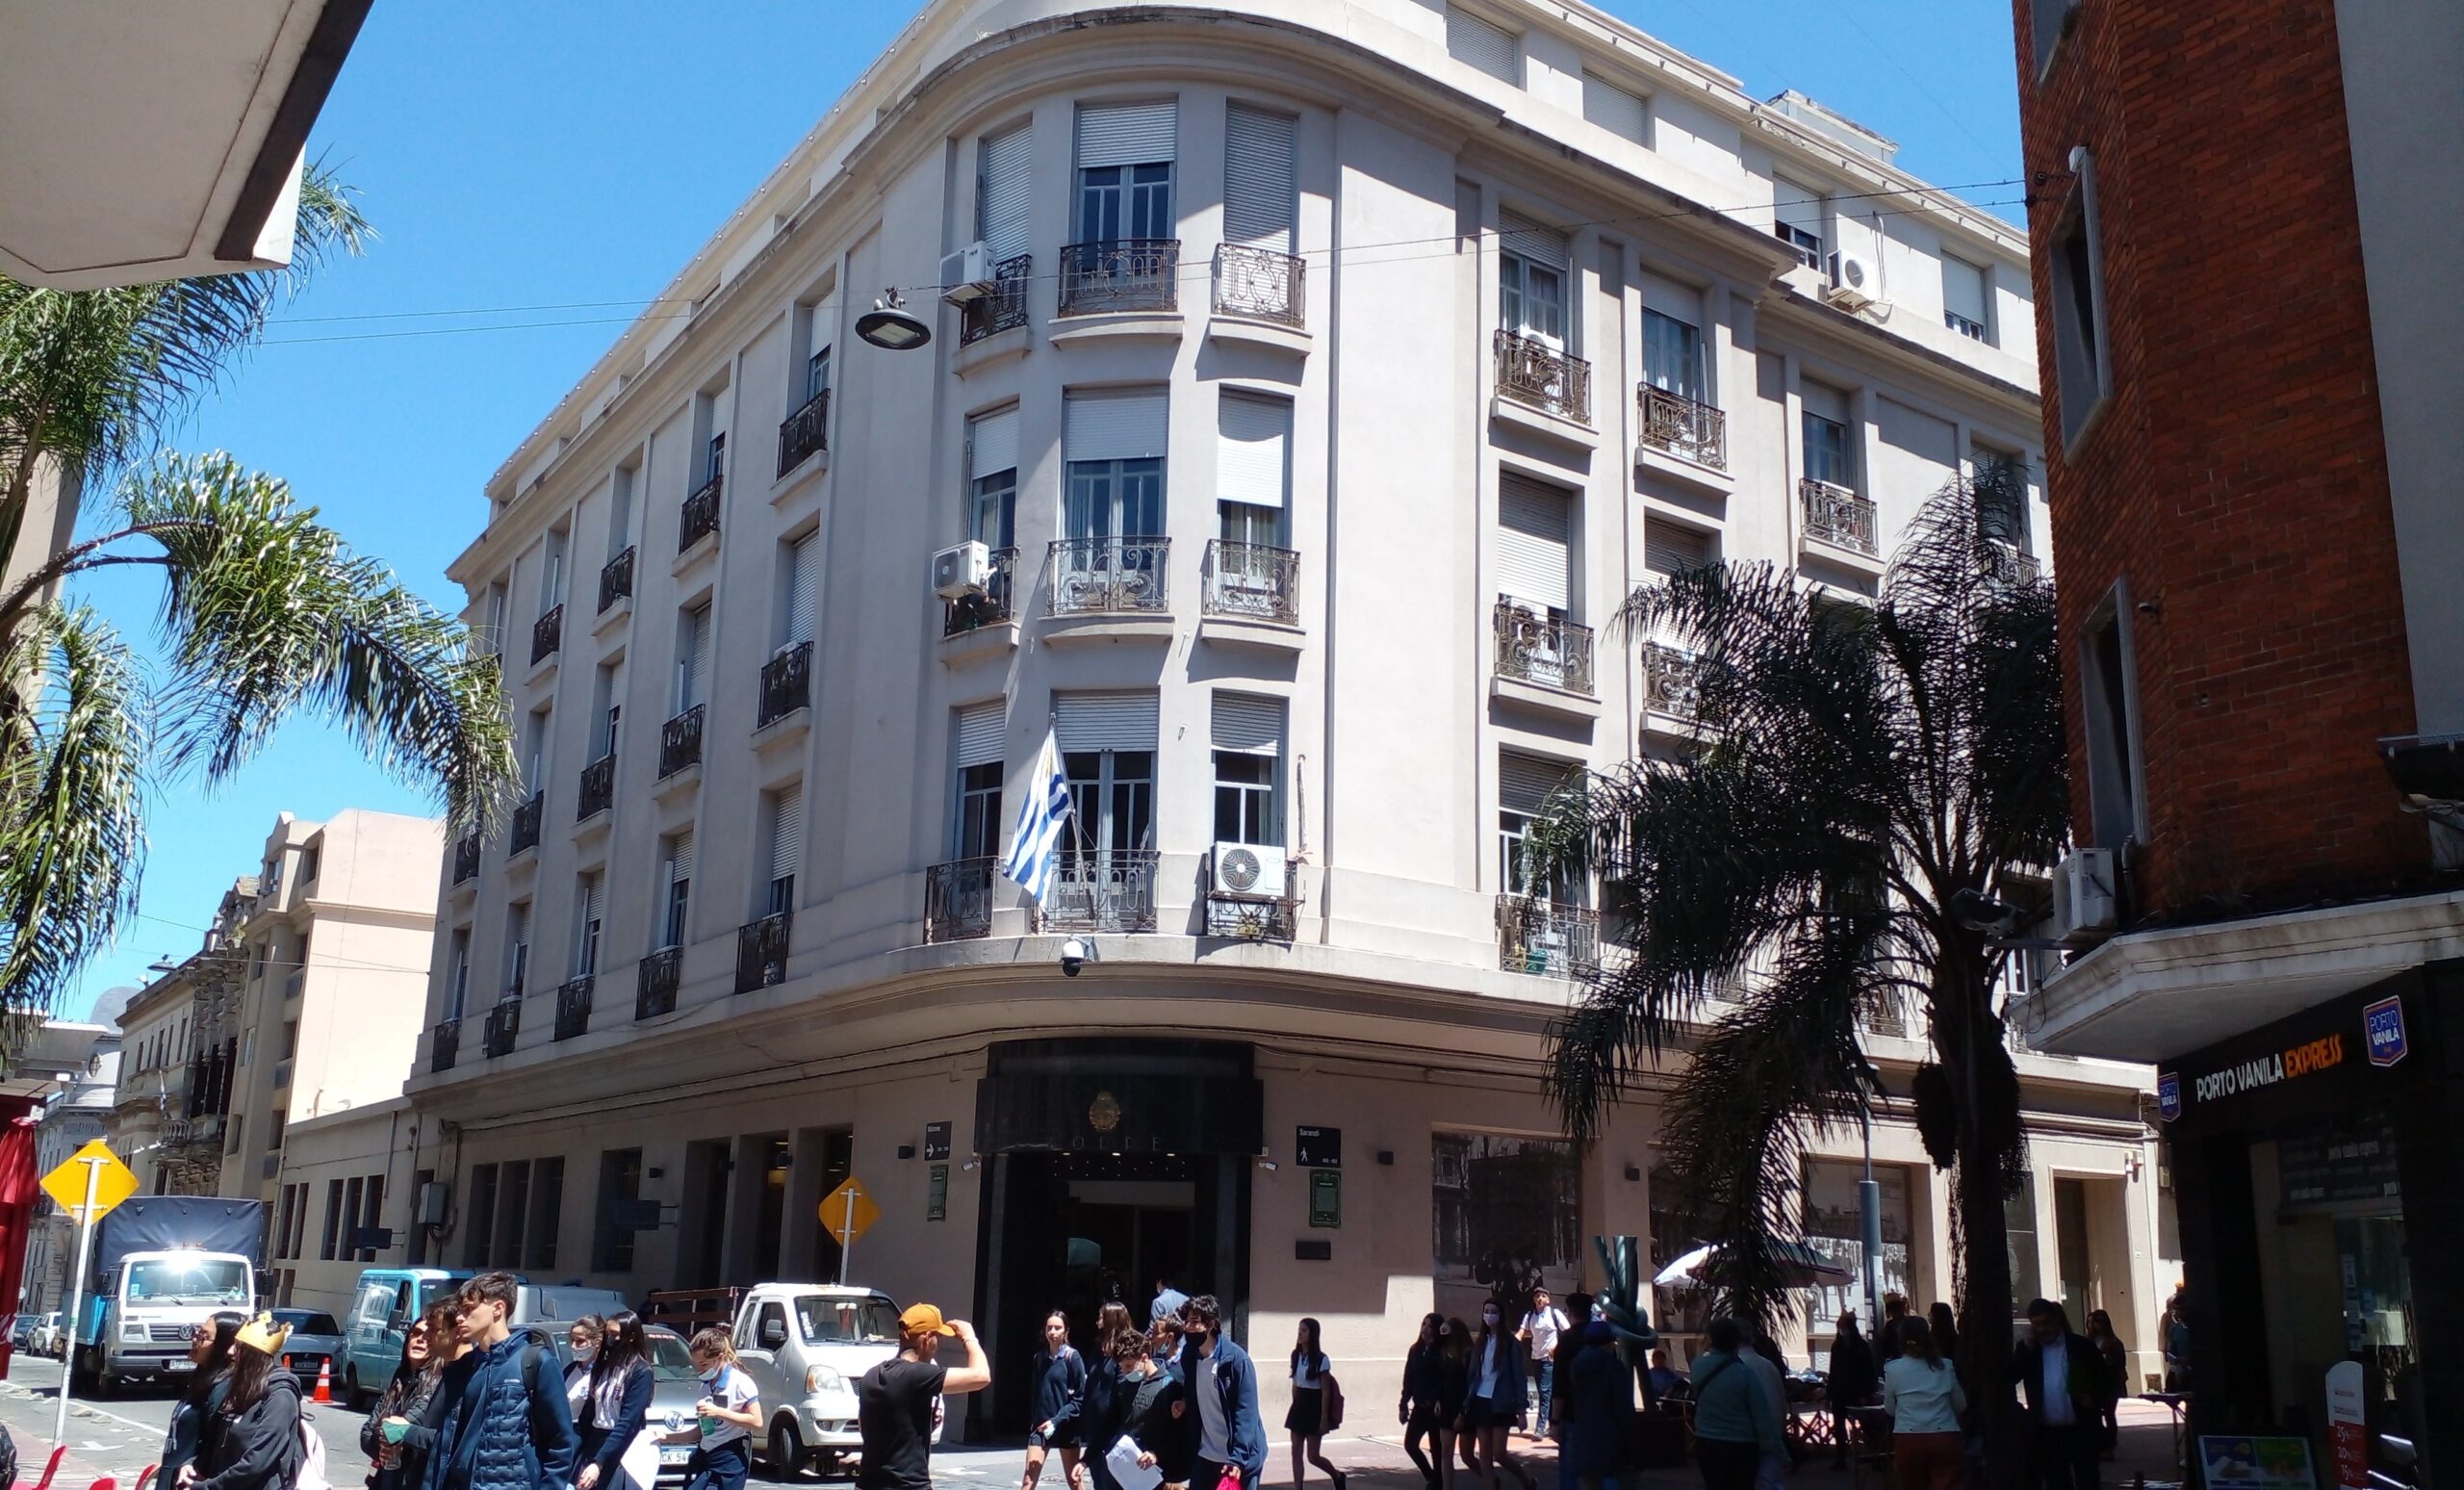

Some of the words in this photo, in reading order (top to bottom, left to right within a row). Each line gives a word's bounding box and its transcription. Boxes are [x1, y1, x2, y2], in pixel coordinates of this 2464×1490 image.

[2370, 1011, 2398, 1032] PORTO
[2372, 1028, 2400, 1046] VANILA
[2196, 1069, 2235, 1102] PORTO
[2237, 1053, 2284, 1091] VANILA
[2285, 1034, 2342, 1078] EXPRESS
